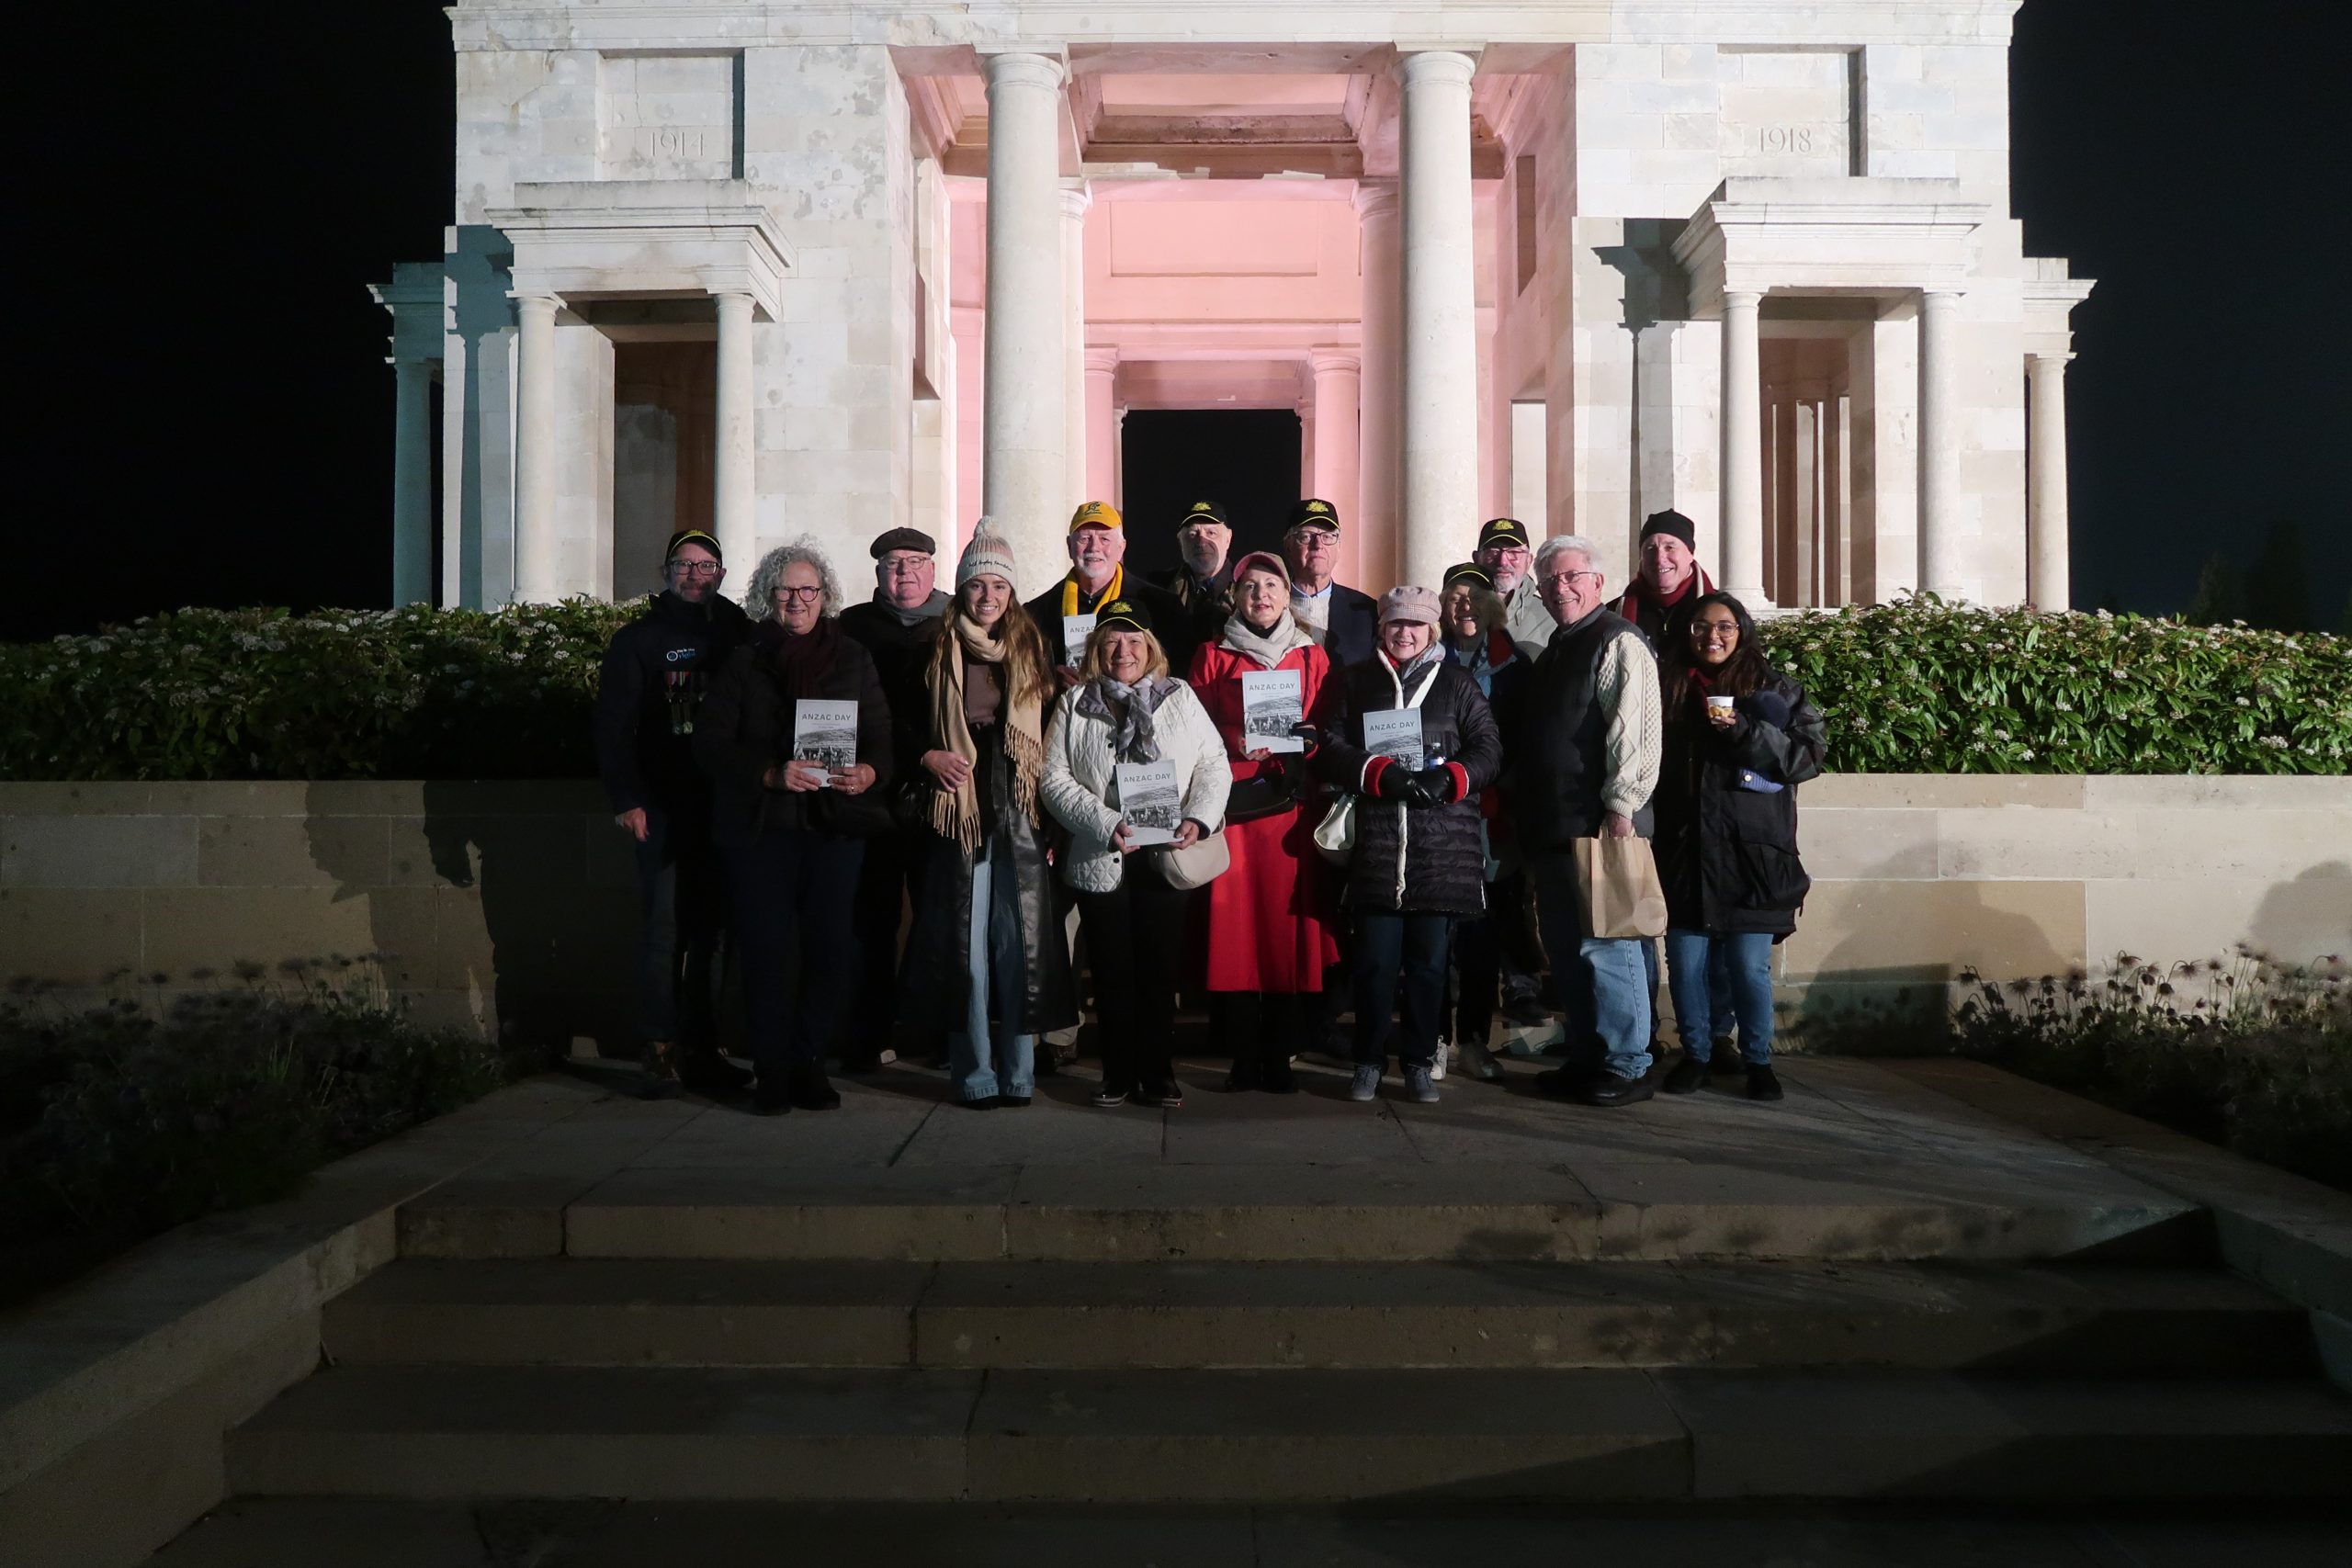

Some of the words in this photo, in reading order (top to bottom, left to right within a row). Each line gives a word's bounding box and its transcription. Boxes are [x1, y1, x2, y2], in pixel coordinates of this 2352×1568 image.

[651, 131, 707, 157] 1914
[1760, 128, 1812, 153] 1918
[1370, 723, 1396, 731] ANZAC
[1124, 774, 1152, 783] ANZAC
